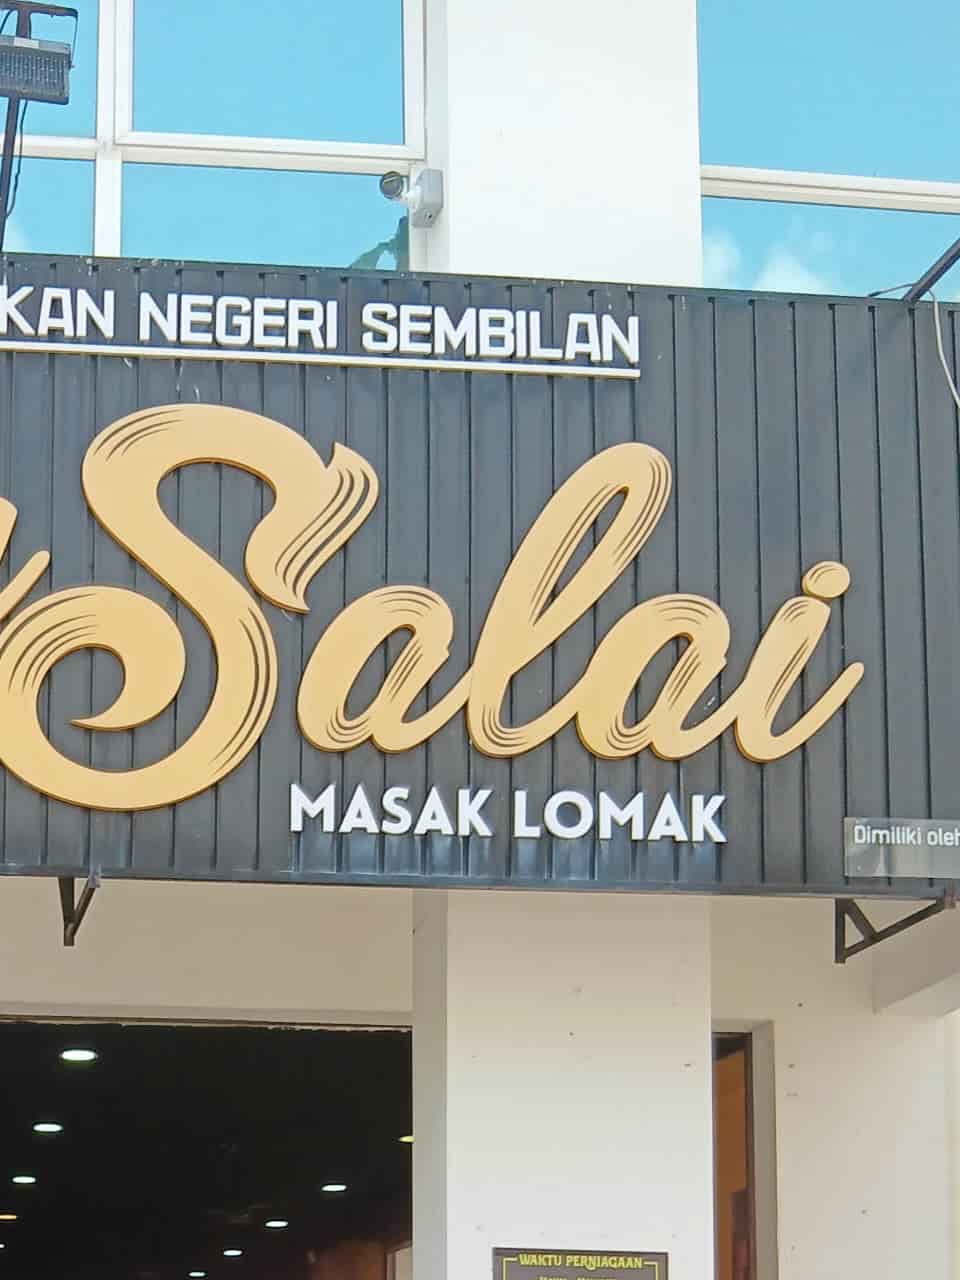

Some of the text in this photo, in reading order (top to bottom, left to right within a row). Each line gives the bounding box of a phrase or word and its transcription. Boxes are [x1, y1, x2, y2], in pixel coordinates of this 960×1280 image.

[139, 293, 338, 350] NEGERI
[361, 302, 639, 363] SEMBILAN
[289, 783, 728, 844] MASAK LOMAK
[854, 825, 921, 846] Dimiliki
[519, 1253, 643, 1270] WAKTU PERNIAGAAN
